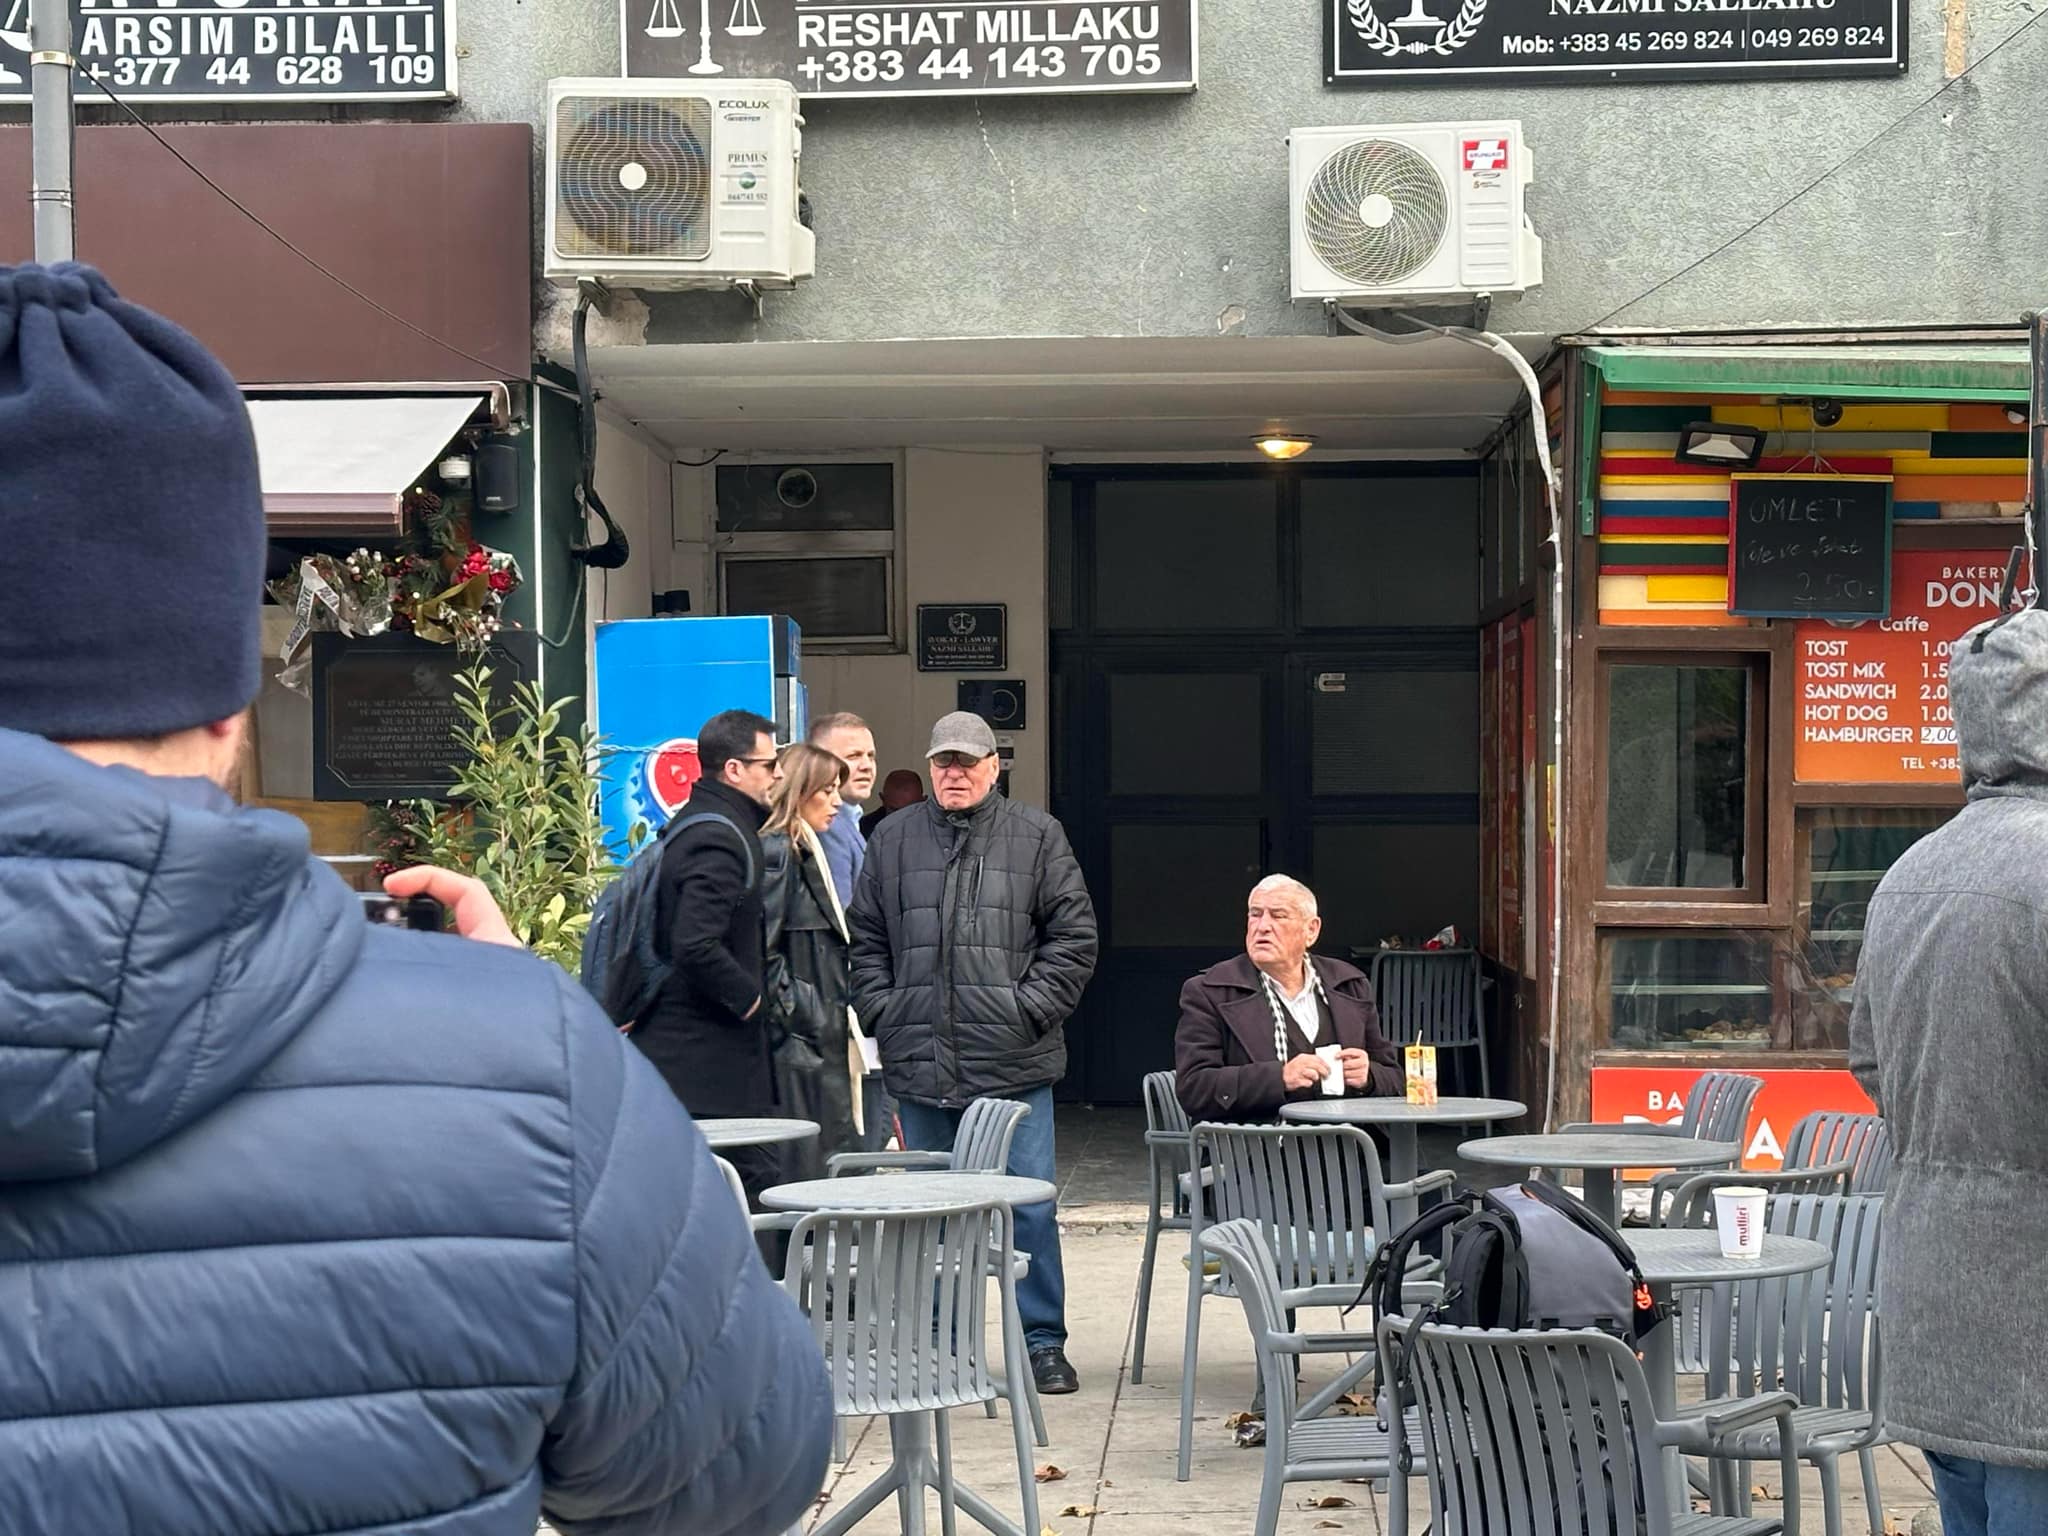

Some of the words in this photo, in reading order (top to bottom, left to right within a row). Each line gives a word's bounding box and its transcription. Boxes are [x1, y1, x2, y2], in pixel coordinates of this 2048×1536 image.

[1548, 0, 1666, 15] NAZMI
[798, 11, 964, 47] RESHAT
[976, 6, 1159, 43] MILLAKU
[80, 16, 233, 56] ARSIM
[254, 14, 434, 54] BILALLI
[1502, 35, 1554, 54] Mob:
[1559, 33, 1609, 52] +383
[1615, 32, 1641, 51] 45
[1647, 31, 1688, 50] 269
[1693, 30, 1733, 49] 824
[1751, 28, 1792, 48] 049
[1798, 27, 1839, 47] 269
[1844, 26, 1885, 46] 824
[80, 57, 181, 86] +377
[205, 57, 251, 85] 44
[276, 56, 343, 85] 628
[369, 55, 434, 84] 109
[797, 49, 905, 83] +383
[918, 48, 973, 80] 44
[988, 46, 1066, 78] 143
[1080, 44, 1161, 76] 705
[718, 100, 770, 109] ECOLUX
[728, 153, 768, 163] PRIMUS
[1926, 581, 2025, 608] DONA
[1879, 616, 1929, 632] Caffe
[1805, 641, 1848, 657] TOST
[1805, 662, 1848, 678] TOST
[1853, 662, 1886, 678] MIX
[1805, 684, 1897, 699] SANDWICH
[1805, 705, 1841, 721] HOT
[1846, 705, 1888, 721] DOG
[1805, 727, 1913, 743] HAMBURGER
[1901, 757, 1925, 769] TEL
[1736, 1207, 1748, 1246] mulliri
